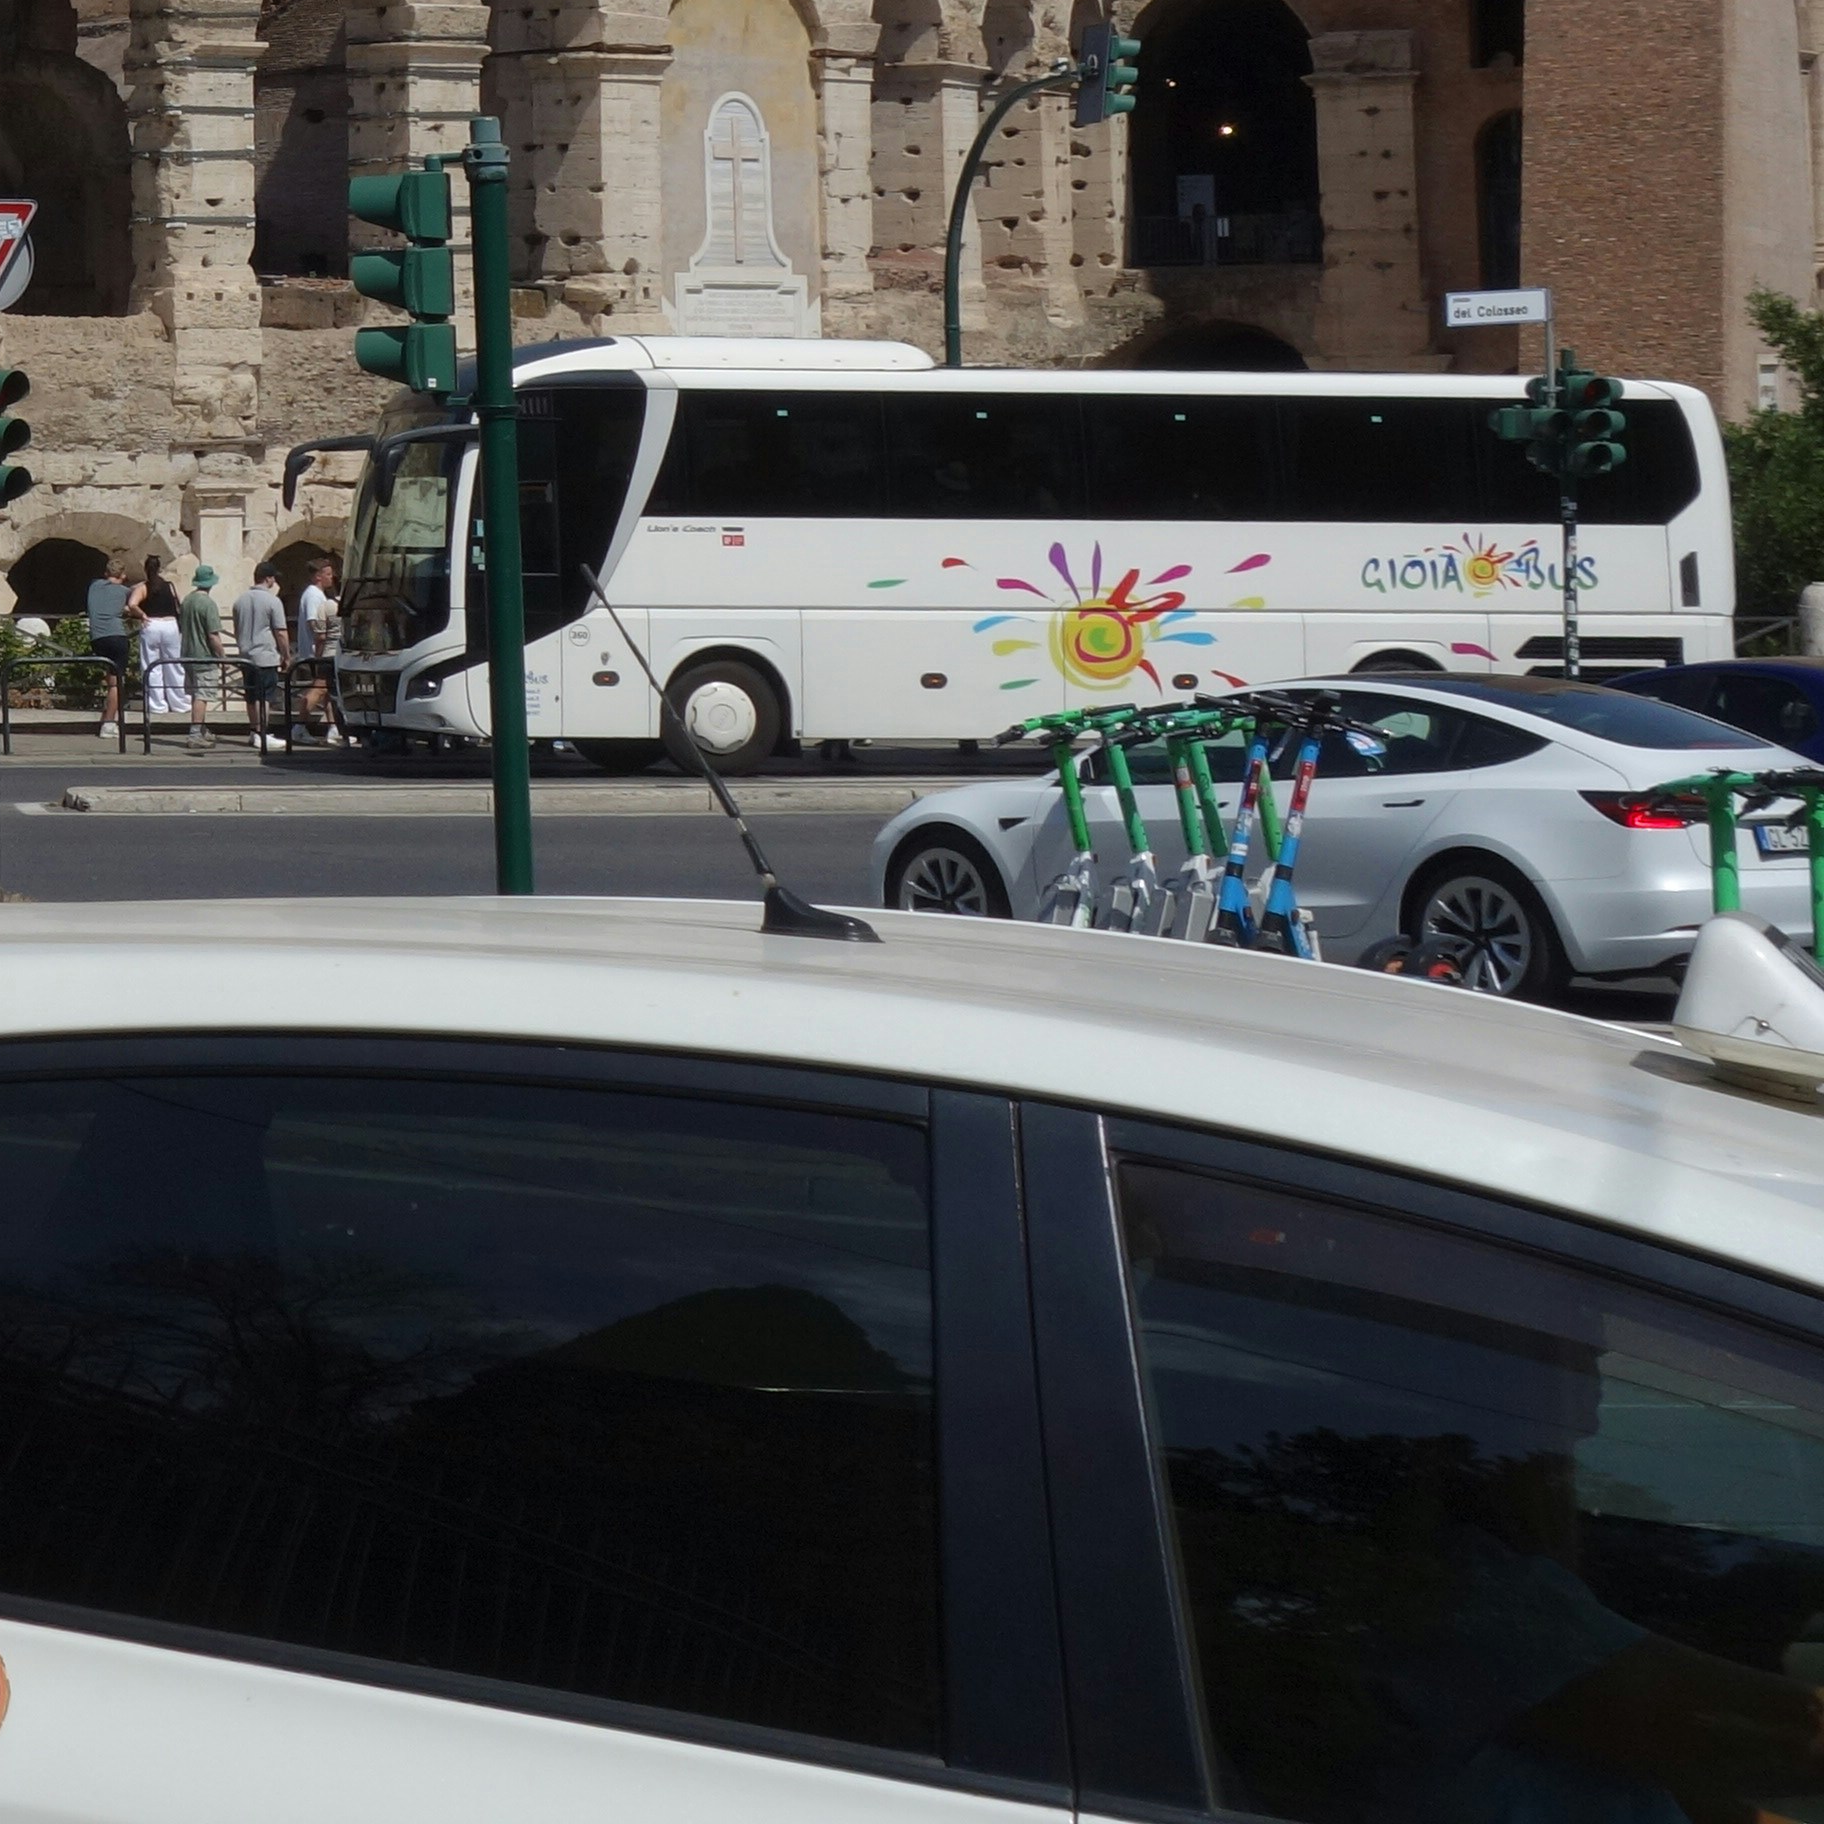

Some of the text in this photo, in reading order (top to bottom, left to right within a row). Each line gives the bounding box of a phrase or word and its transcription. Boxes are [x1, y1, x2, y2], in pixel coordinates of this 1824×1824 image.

[1453, 305, 1529, 319] del Colosseo
[1360, 552, 1464, 594] GIOIA
